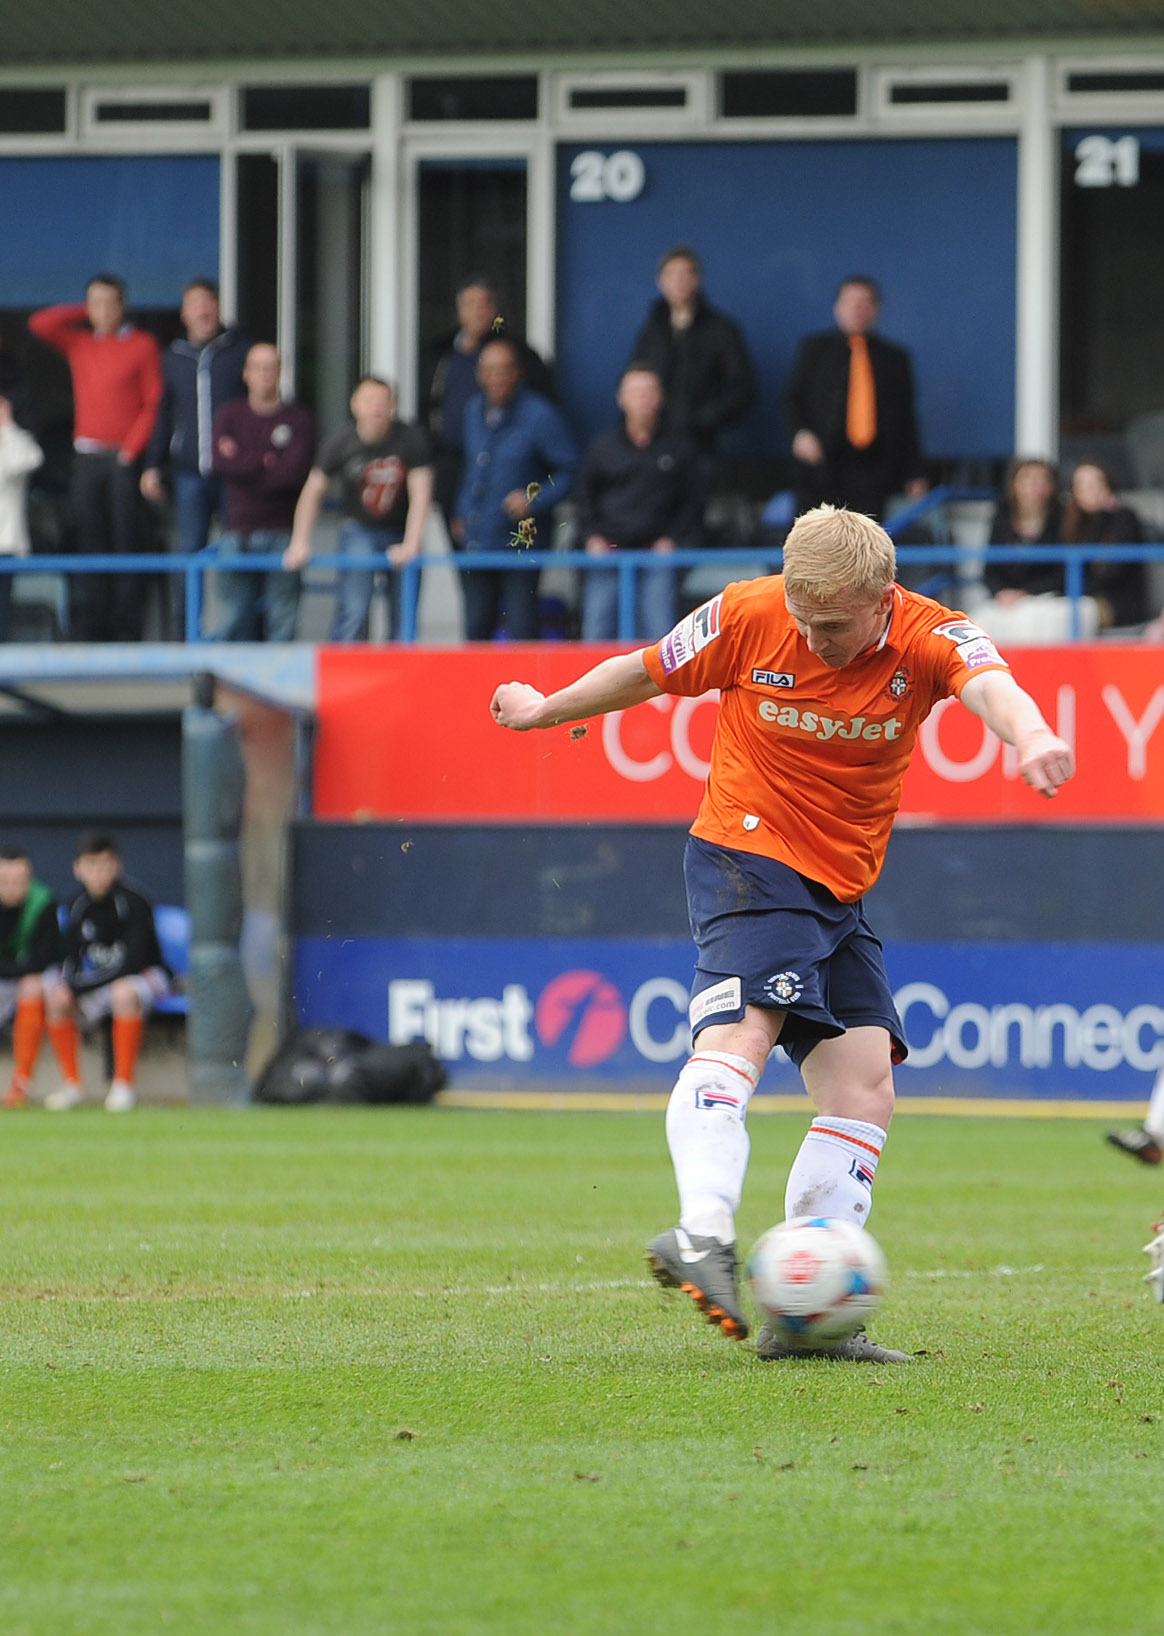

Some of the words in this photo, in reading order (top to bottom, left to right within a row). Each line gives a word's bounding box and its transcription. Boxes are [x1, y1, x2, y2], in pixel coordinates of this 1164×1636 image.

[569, 151, 645, 202] 20
[1074, 135, 1138, 187] 21
[754, 671, 790, 686] FILA
[758, 700, 901, 741] easyJet
[388, 979, 533, 1062] First
